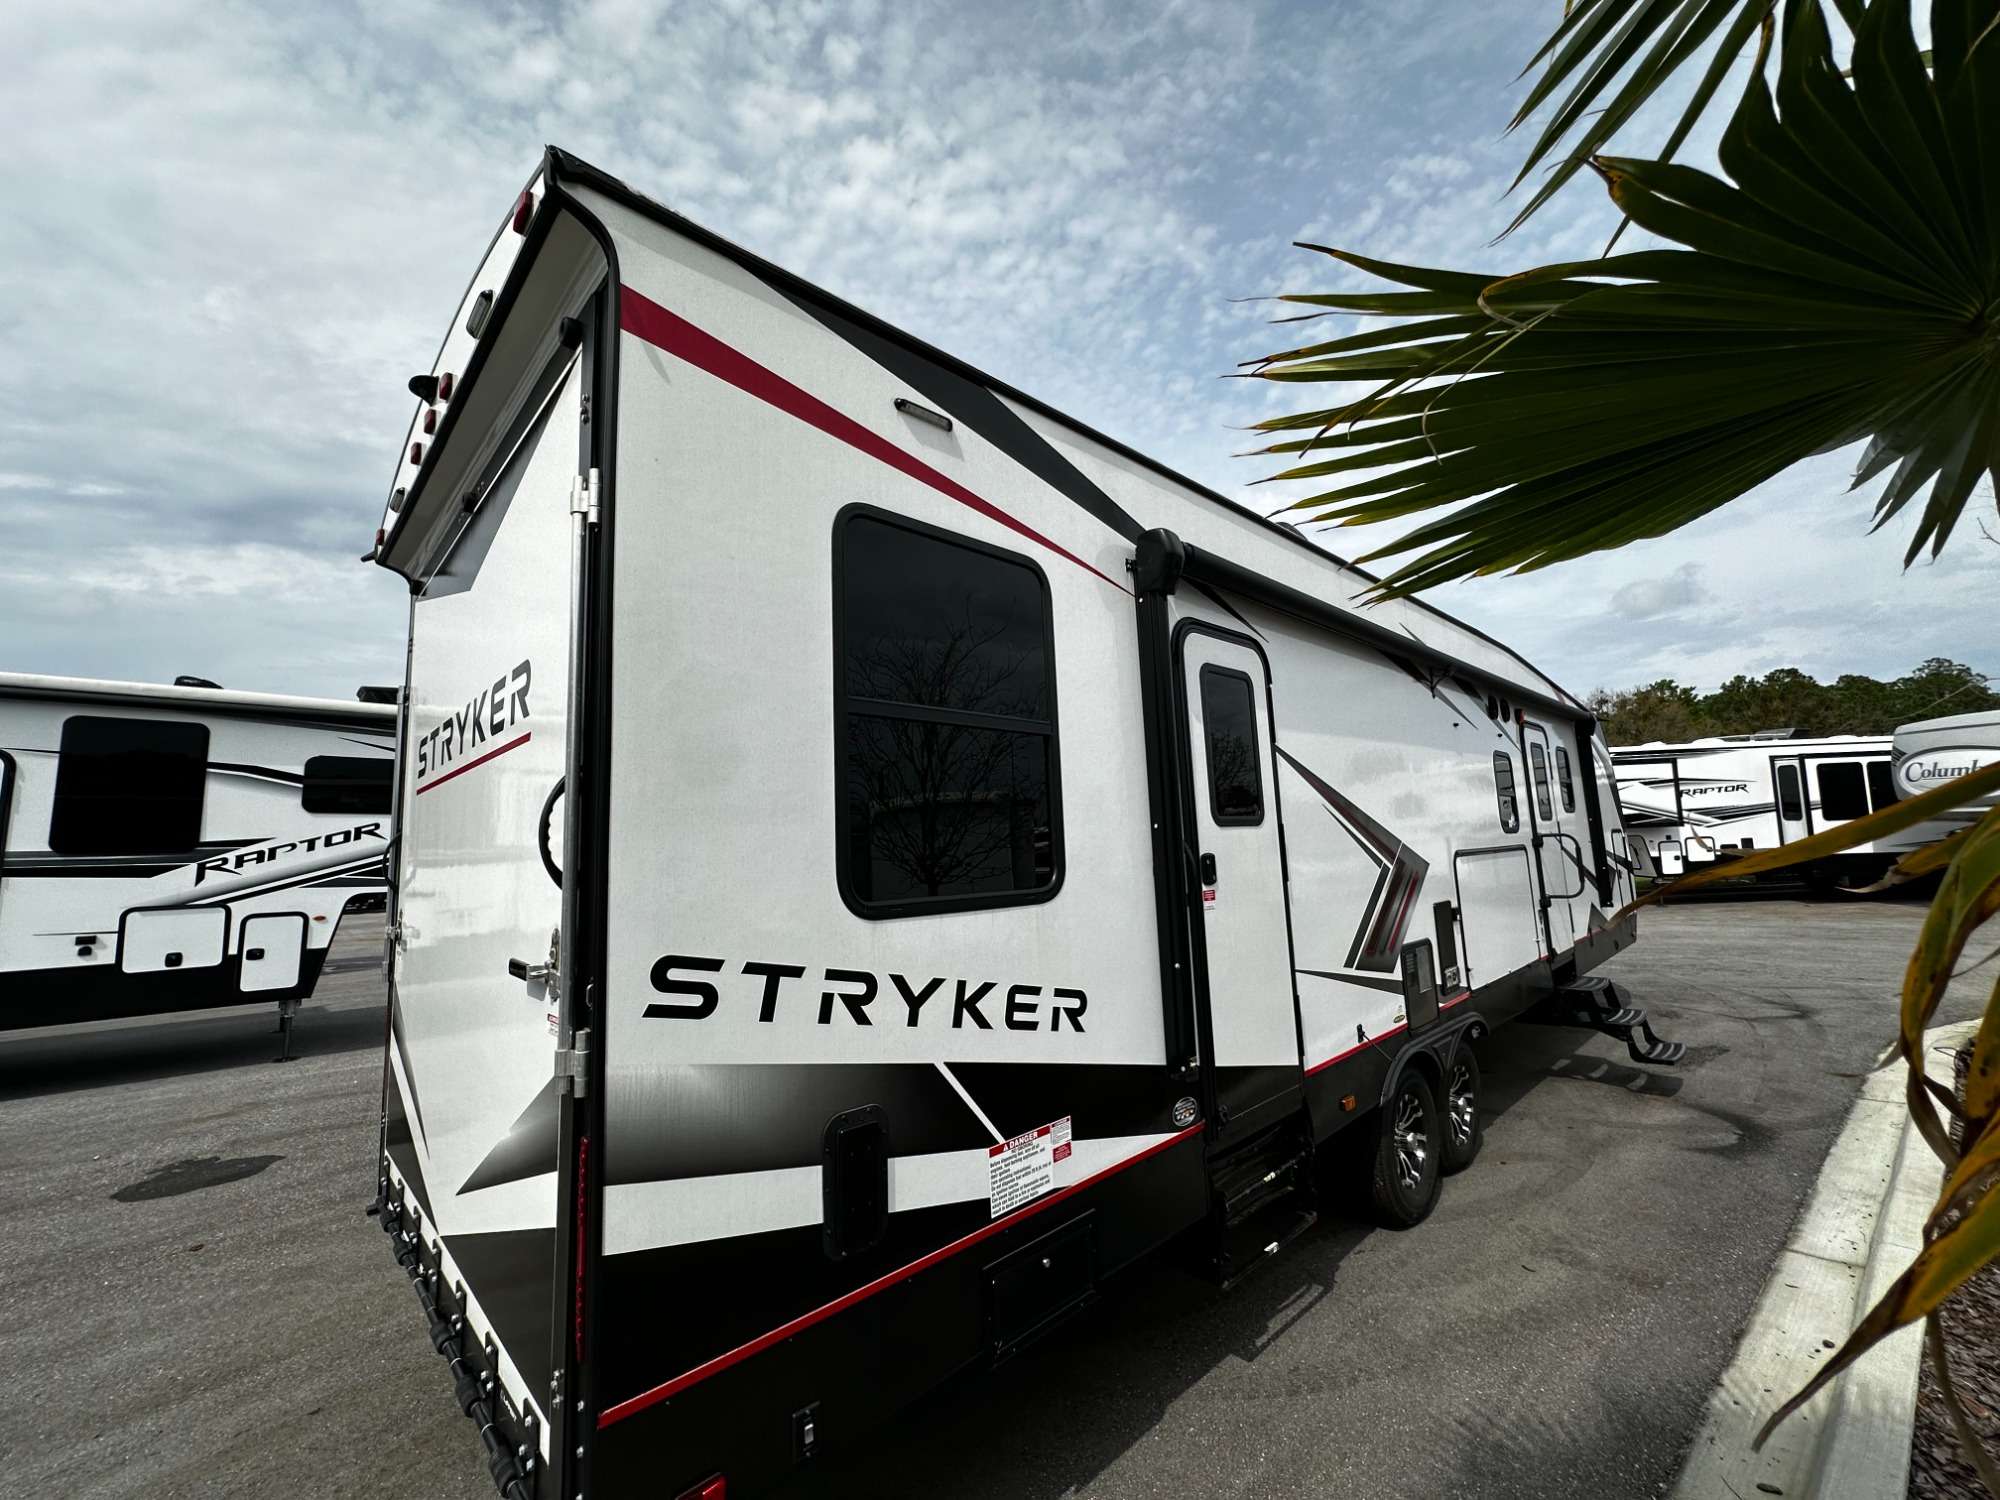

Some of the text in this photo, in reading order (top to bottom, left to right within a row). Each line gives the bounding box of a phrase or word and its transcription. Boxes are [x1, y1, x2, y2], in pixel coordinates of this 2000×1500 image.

[417, 658, 532, 779] STRYKER
[1679, 783, 1750, 798] RAPTOR
[194, 822, 388, 888] RAPTOR
[641, 954, 1088, 1033] STRYKER
[1009, 1131, 1038, 1149] DANGER
